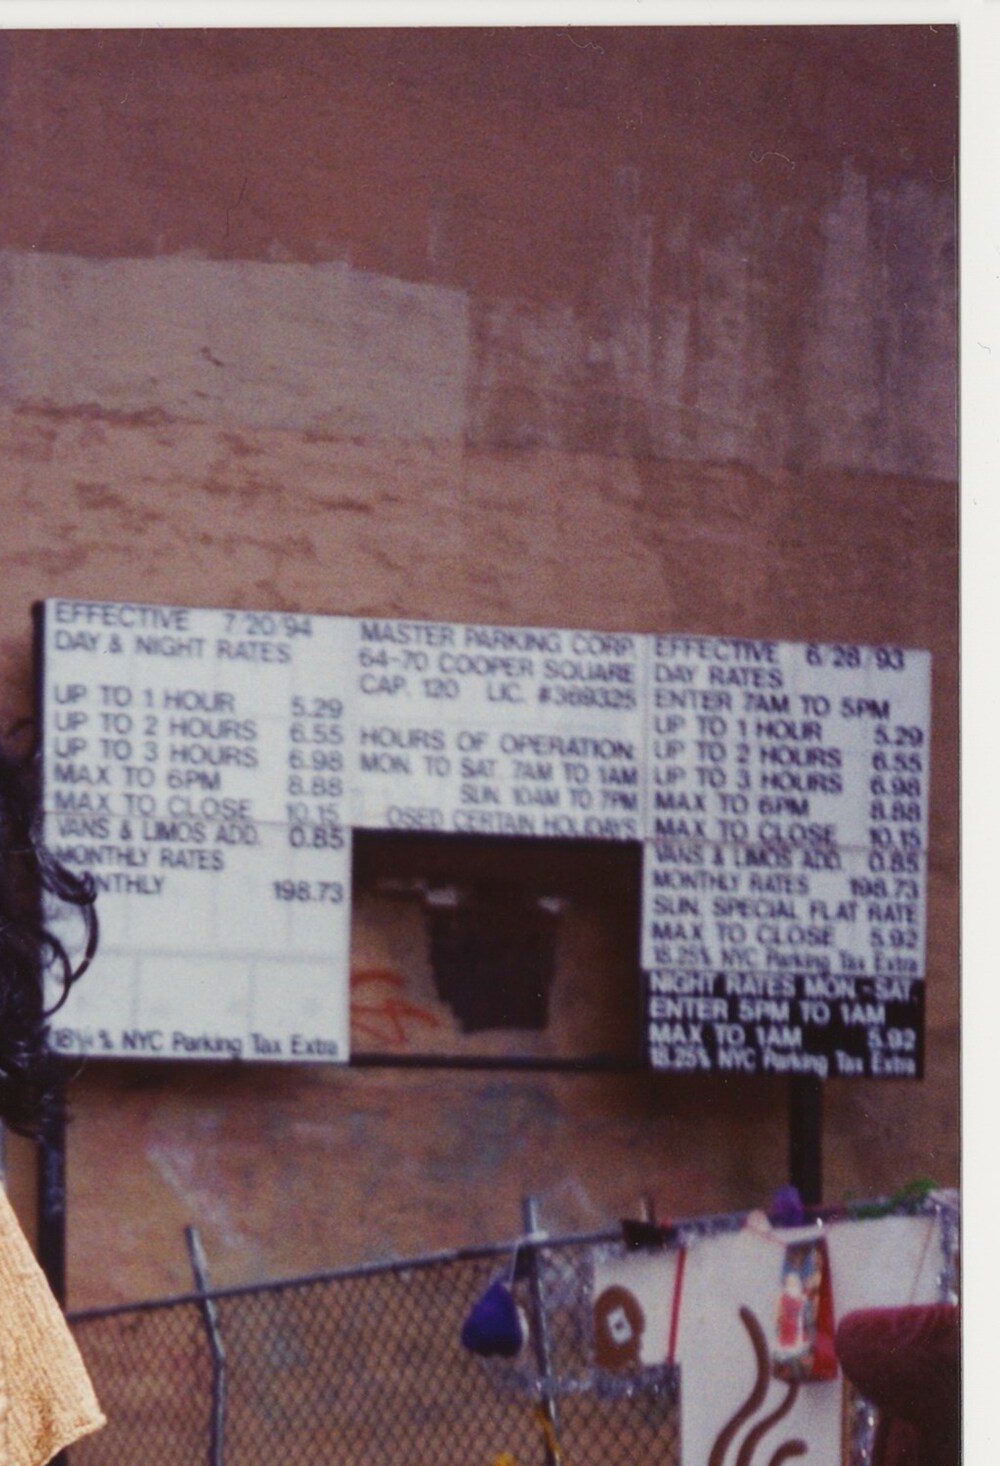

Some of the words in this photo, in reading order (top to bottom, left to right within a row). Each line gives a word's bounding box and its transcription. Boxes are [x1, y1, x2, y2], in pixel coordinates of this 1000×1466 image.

[54, 604, 189, 630] EFFECTIVE
[54, 630, 99, 651] DAY
[108, 634, 122, 654] &
[135, 636, 206, 657] NIGHT
[216, 640, 291, 664] RATES
[360, 621, 455, 646] MASTER
[465, 626, 561, 652] PARKING
[655, 638, 779, 663] EFFECTIVE
[358, 648, 429, 671] 64-70
[439, 652, 533, 677] COOPER
[544, 660, 634, 684] SQUARE
[655, 664, 696, 683] DAY
[709, 667, 783, 689] RATES
[53, 684, 87, 704] UP
[99, 685, 133, 707] TO
[144, 689, 154, 708] 1
[163, 690, 236, 714] HOUR
[290, 696, 343, 719] 5.29
[655, 689, 732, 711] ENTER
[744, 692, 790, 713] 7AM
[801, 695, 830, 717] TO
[841, 697, 889, 719] 5PM
[53, 713, 88, 733] UP
[99, 714, 133, 736] TO
[143, 716, 158, 737] 2
[168, 717, 259, 742] HOURS
[288, 722, 343, 745] 6.55
[655, 715, 685, 734] UP
[697, 715, 727, 737] TO
[738, 718, 747, 738] 1
[756, 719, 822, 741] HOUR
[53, 738, 87, 759] UP
[99, 739, 133, 761] TO
[143, 742, 159, 763] 3
[168, 743, 259, 769] HOURS
[287, 749, 344, 772] 6.98
[360, 727, 445, 751] HOURS
[457, 731, 488, 752] OF
[500, 733, 634, 760] OPERATION
[655, 740, 684, 759] UP
[696, 741, 726, 762] TO
[737, 744, 749, 764] 2
[760, 746, 843, 769] HOURS
[53, 765, 111, 786] MAX
[123, 767, 156, 790] TO
[166, 769, 221, 791] 6PM
[360, 753, 410, 775] MON
[424, 755, 451, 777] TO
[460, 758, 497, 779] SAT
[563, 762, 589, 784] TO
[655, 766, 685, 786] UP
[696, 767, 726, 789] TO
[737, 770, 750, 790] 3
[760, 771, 843, 794] HOURS
[53, 791, 111, 813] MAX
[123, 793, 156, 816] TO
[166, 796, 251, 821] CLOSE
[461, 783, 499, 804] SUN
[513, 786, 560, 807] 10AM
[569, 788, 592, 809] TO
[655, 791, 705, 812] MAX
[719, 793, 749, 815] TO
[57, 817, 110, 838] VANS
[120, 819, 133, 840] &
[143, 820, 206, 844] LIMOS
[288, 826, 344, 849] 0.85
[453, 809, 534, 833] CERTAIN
[544, 813, 637, 836] HOLIDAYS
[655, 817, 705, 837] MAX
[718, 819, 748, 841] TO
[758, 821, 836, 845] CLOSE
[55, 845, 148, 867] MONTHLY
[159, 849, 224, 871] RATES
[734, 849, 793, 869] LIMOS
[82, 872, 164, 895] NTHLY
[272, 879, 344, 903] 198.73
[653, 869, 739, 890] MONTHLY
[750, 873, 809, 895] RATES
[712, 898, 796, 919] SPECIAL
[809, 900, 858, 922] FLAT
[867, 902, 916, 924] RATE
[652, 921, 702, 941] MAX
[716, 922, 747, 944] TO
[756, 924, 834, 946] CLOSE
[721, 948, 758, 968] NYC
[765, 949, 831, 974] Parking
[837, 951, 865, 971] Tax
[872, 951, 918, 972] Extra
[651, 971, 714, 995] NIGHT
[725, 974, 796, 998] RATES
[803, 975, 855, 999] MON
[650, 999, 729, 1021] ENTER
[738, 1000, 790, 1023] 5PM
[800, 1001, 831, 1024] TO
[121, 1030, 163, 1051] NYC
[171, 1031, 242, 1058] Parking
[250, 1032, 282, 1054] Tax
[290, 1034, 339, 1056] Extra
[650, 1023, 702, 1044] MAX
[715, 1024, 746, 1046] TO
[719, 1048, 756, 1070] NYC
[763, 1050, 828, 1078] Parking
[835, 1051, 865, 1072] Tax
[871, 1053, 915, 1074] Extra
